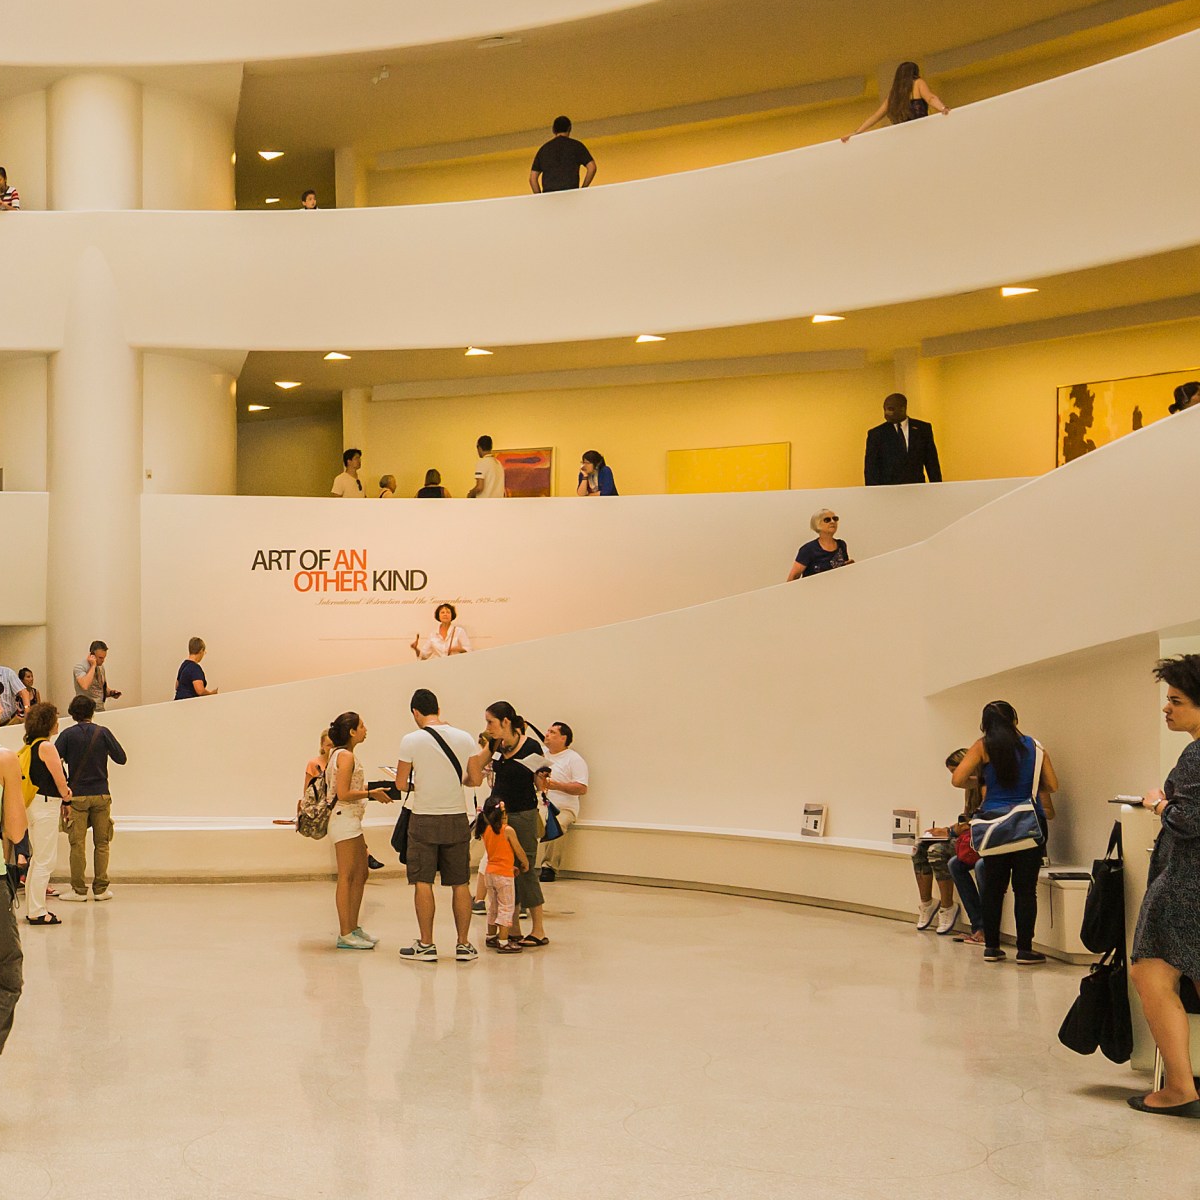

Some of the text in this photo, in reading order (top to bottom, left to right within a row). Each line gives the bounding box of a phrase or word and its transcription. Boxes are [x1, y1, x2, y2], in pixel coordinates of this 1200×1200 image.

[251, 549, 367, 570] ART OF AN
[293, 569, 428, 592] OTHER KIND
